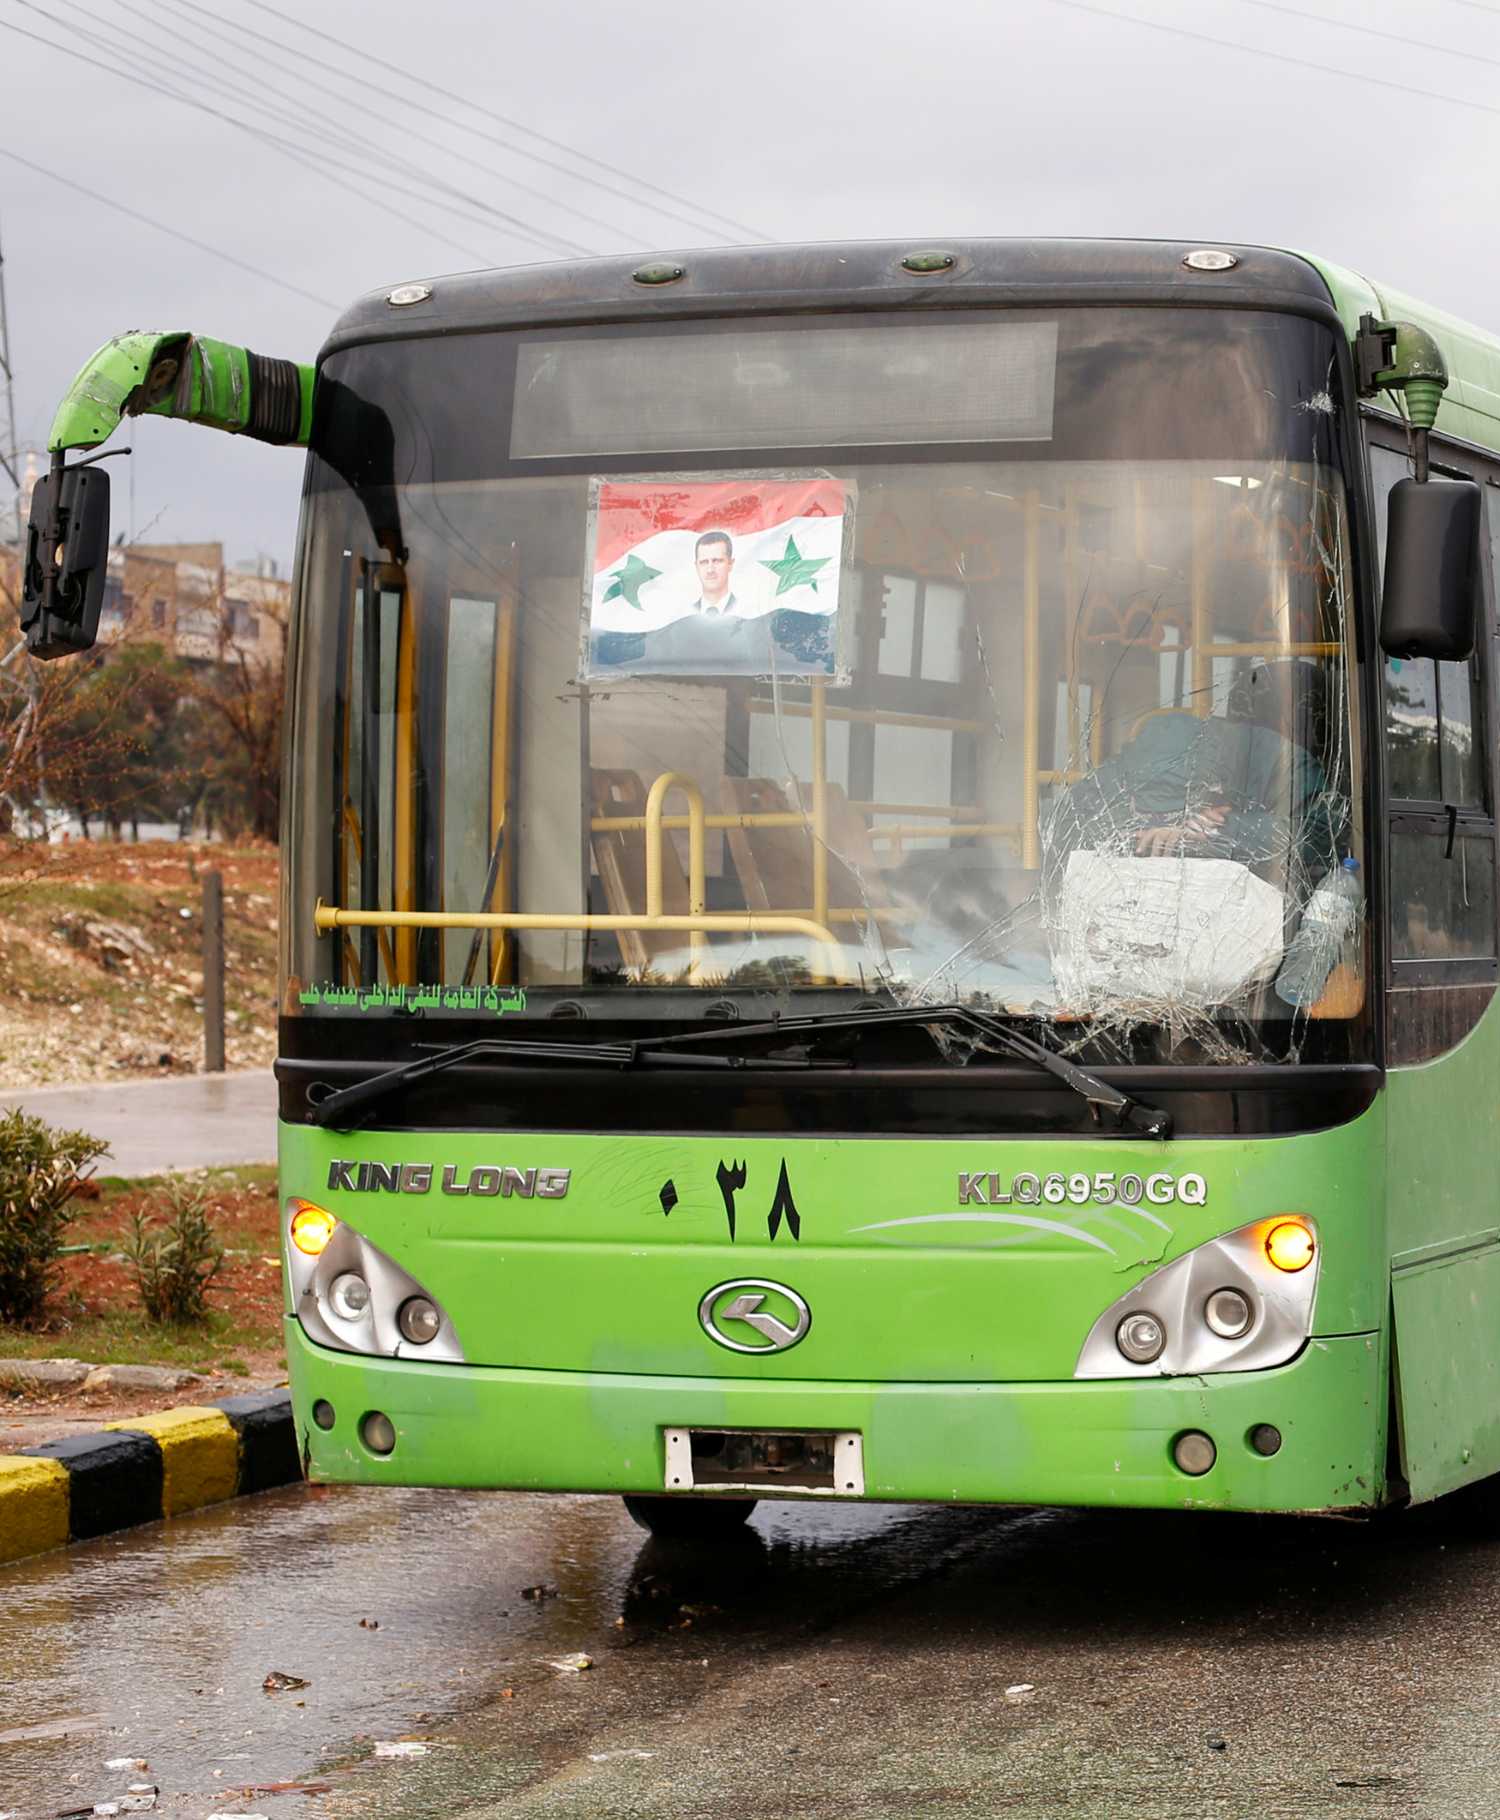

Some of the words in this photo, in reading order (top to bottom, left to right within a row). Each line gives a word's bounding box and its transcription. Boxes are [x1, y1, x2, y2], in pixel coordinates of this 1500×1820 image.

[443, 984, 481, 1010] العامة
[484, 984, 527, 1016] الشركة
[327, 1159, 433, 1194] KING
[442, 1164, 572, 1199] LONG
[958, 1171, 1208, 1206] KLQ6950GQ
[658, 1156, 801, 1243] ٠٣٨
